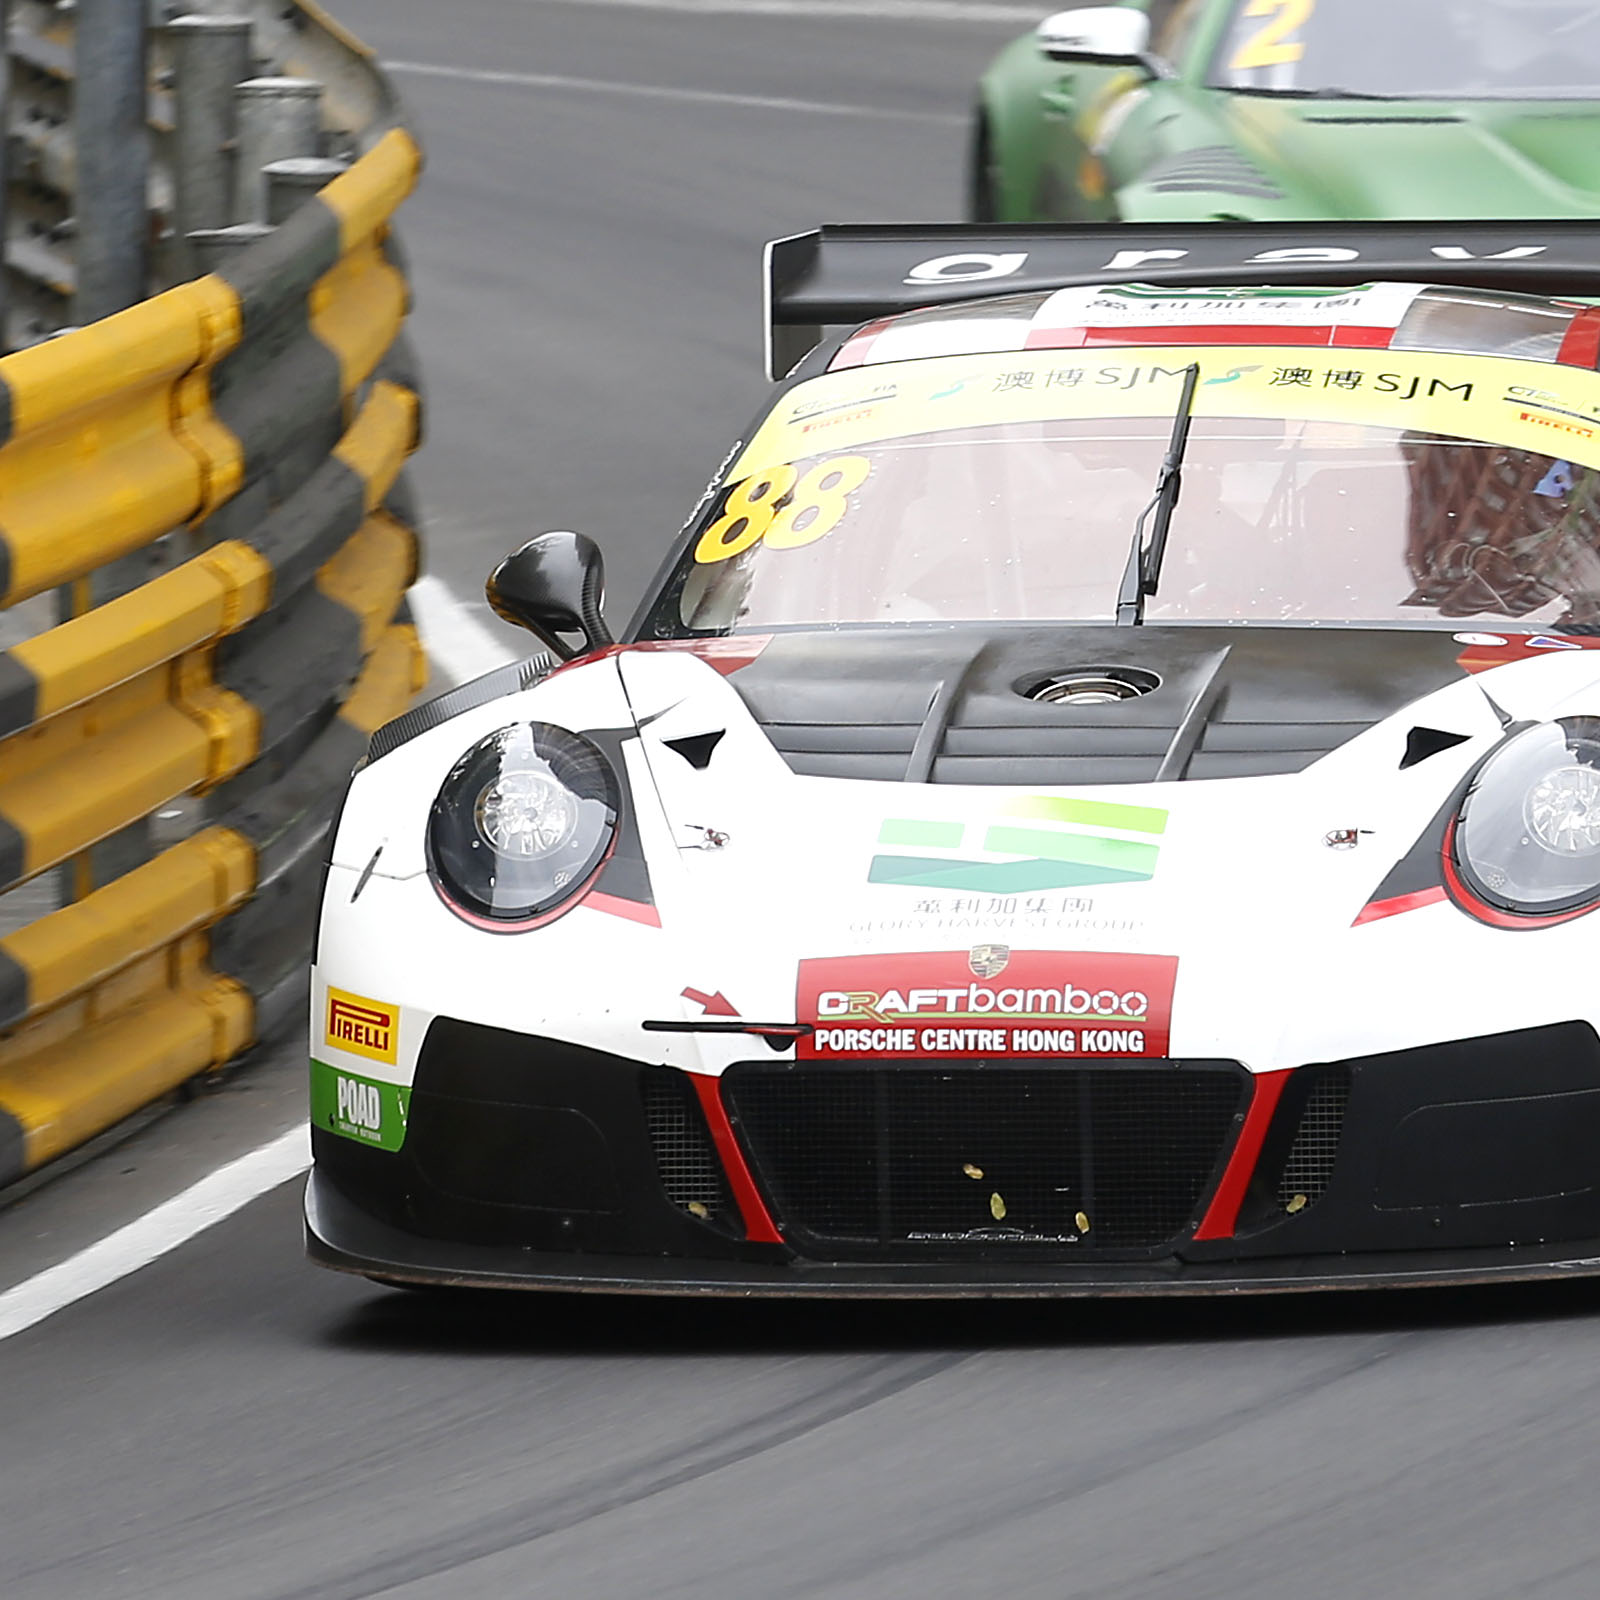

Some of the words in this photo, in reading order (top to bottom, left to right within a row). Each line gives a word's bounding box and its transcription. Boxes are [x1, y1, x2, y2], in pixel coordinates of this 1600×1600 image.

[694, 454, 873, 565] 88
[329, 998, 391, 1051] PIRELLI
[815, 1028, 916, 1052] PORSCHE
[921, 1028, 1006, 1052] CENTRE
[1012, 1029, 1075, 1052] HONG
[1081, 1030, 1145, 1053] KONG
[337, 1076, 381, 1131] POAD
